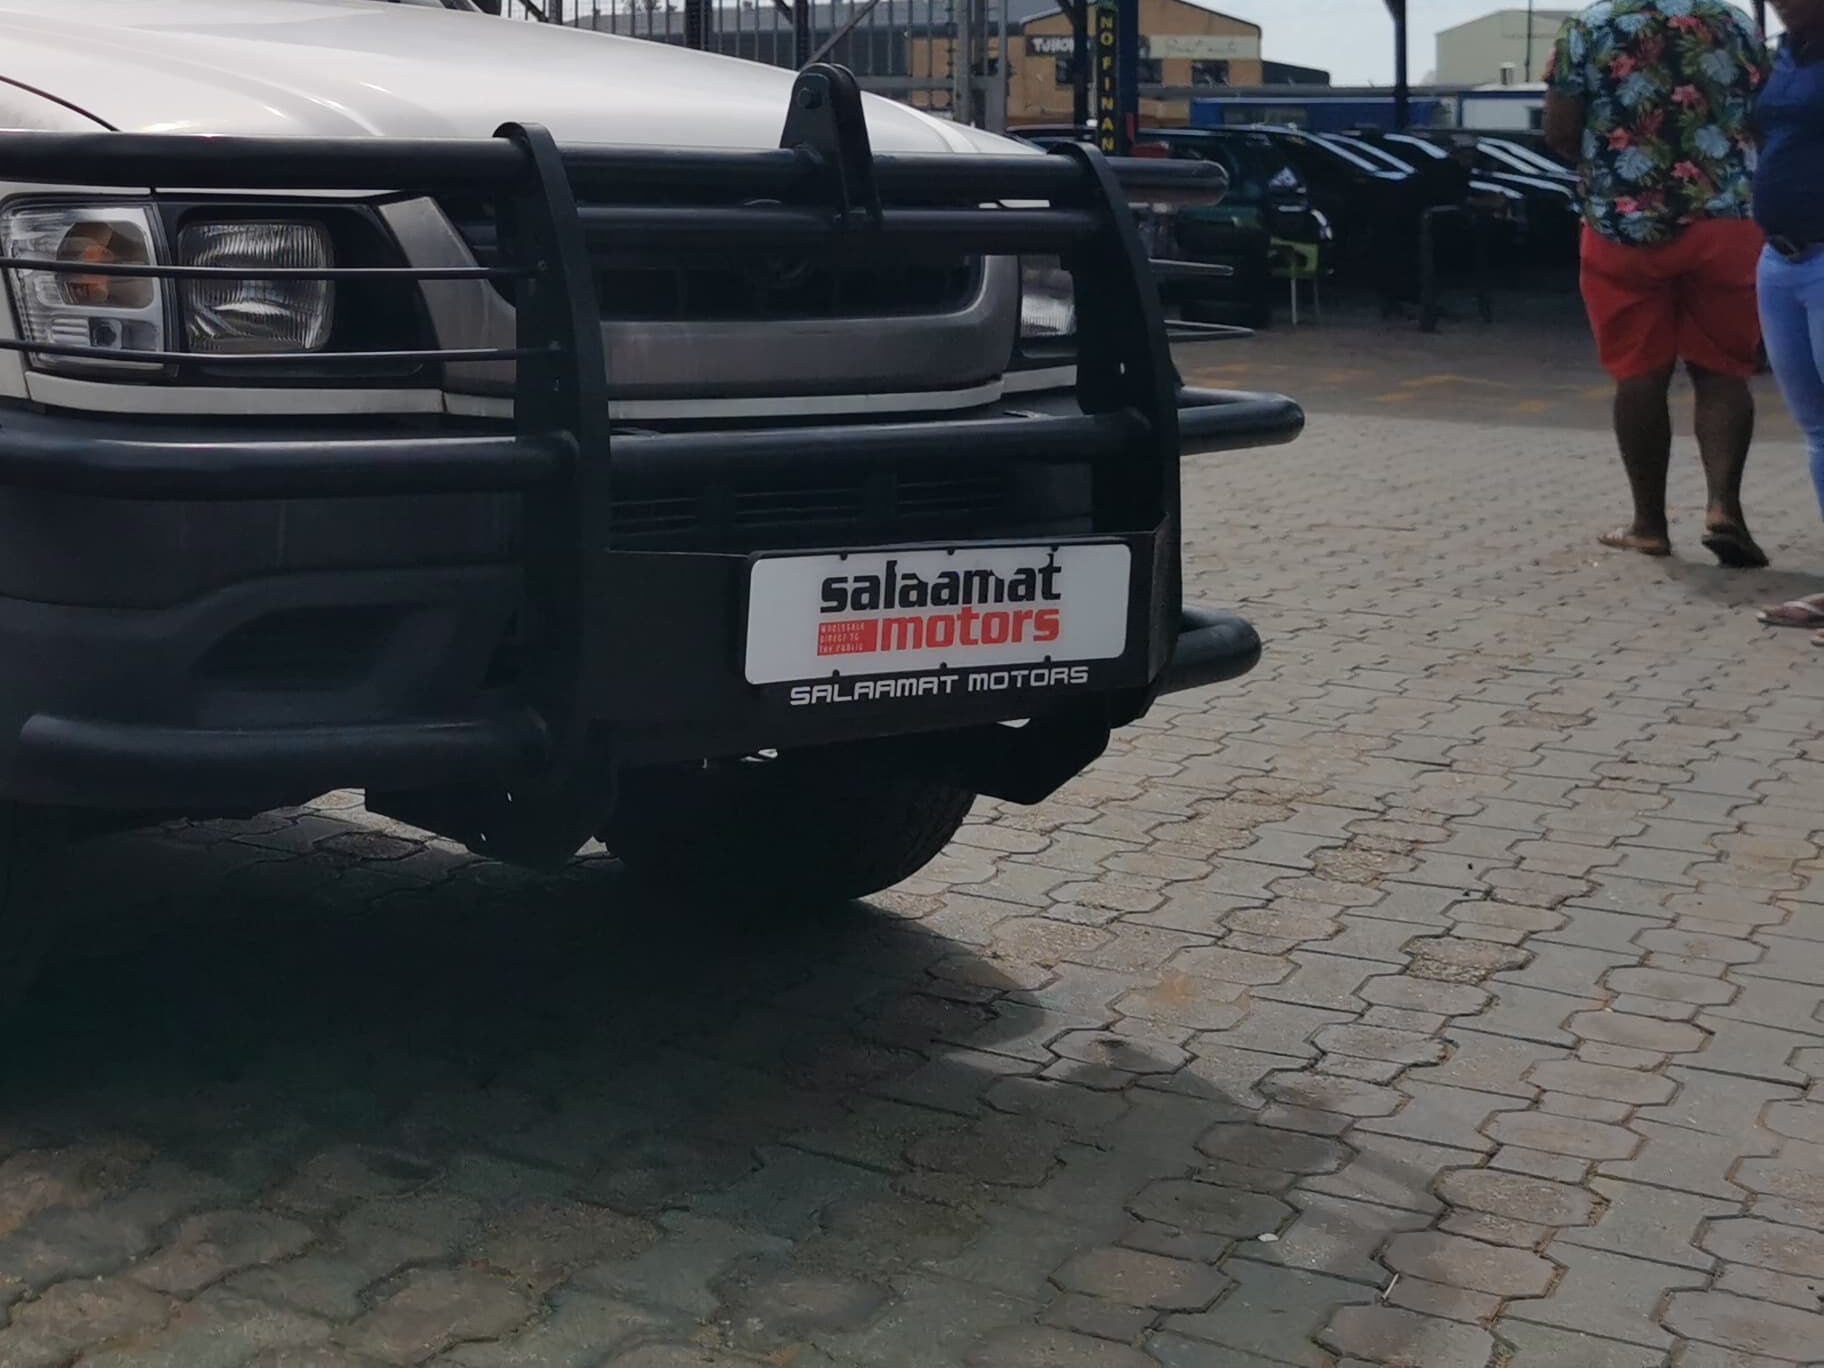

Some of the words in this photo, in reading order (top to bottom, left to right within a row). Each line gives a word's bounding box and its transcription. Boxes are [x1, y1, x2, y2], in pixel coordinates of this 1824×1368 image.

[820, 552, 1062, 614] salaamat
[880, 607, 1060, 651] motors
[789, 675, 959, 705] SALAAMAT
[967, 665, 1089, 692] MOTORS
